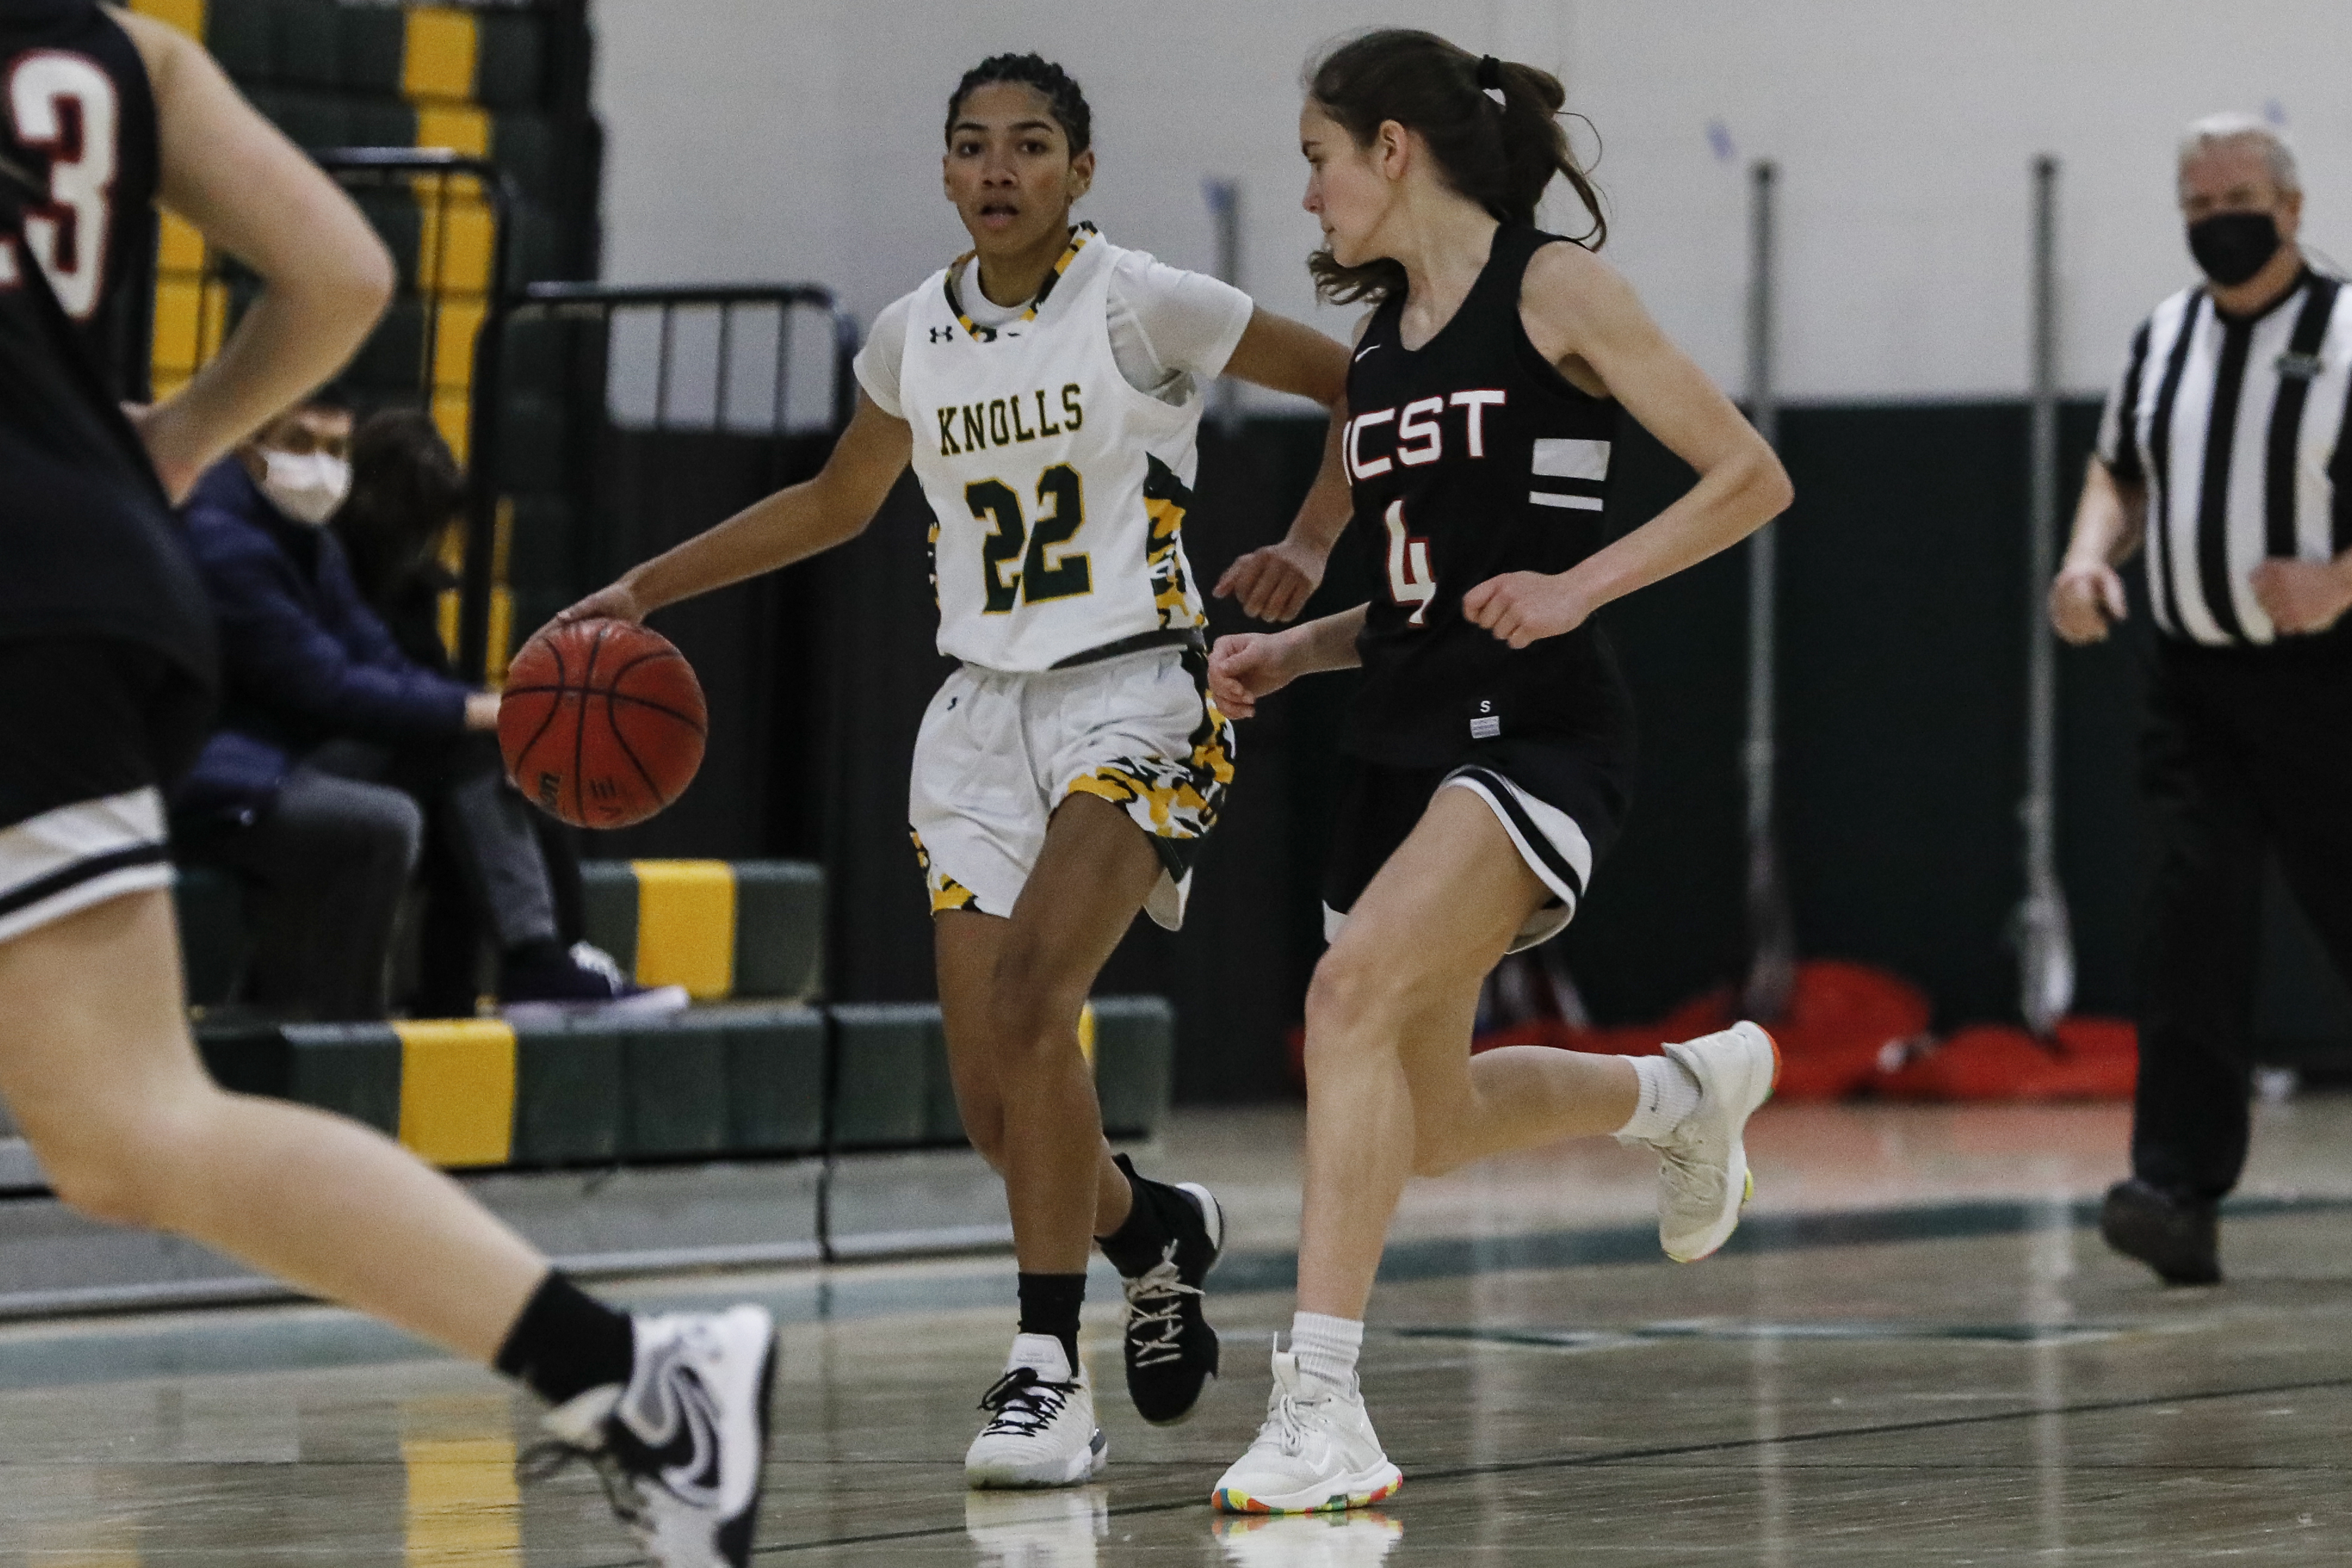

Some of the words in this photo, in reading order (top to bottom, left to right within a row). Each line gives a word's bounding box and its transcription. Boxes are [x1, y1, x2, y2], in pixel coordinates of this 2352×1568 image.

[937, 382, 1083, 457] KNOLLS
[965, 462, 1094, 616] 22
[1384, 499, 1436, 627] 4
[1480, 700, 1491, 713] S
